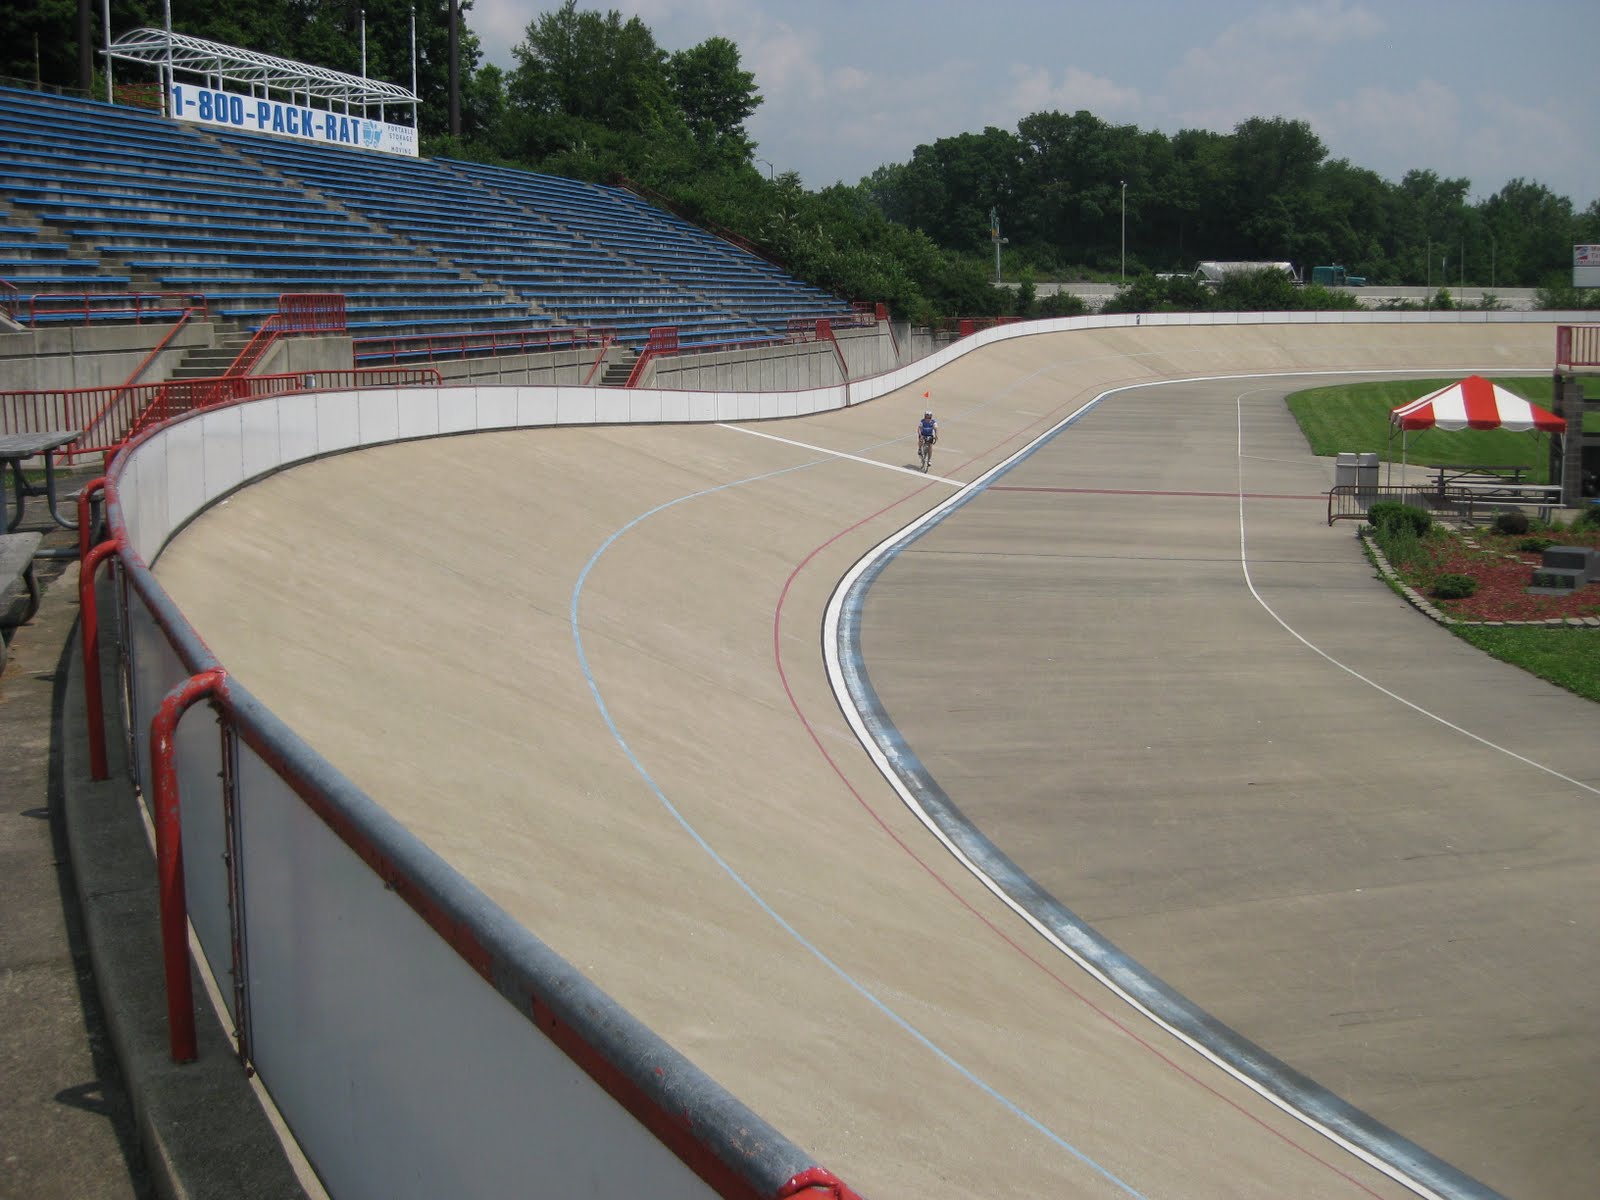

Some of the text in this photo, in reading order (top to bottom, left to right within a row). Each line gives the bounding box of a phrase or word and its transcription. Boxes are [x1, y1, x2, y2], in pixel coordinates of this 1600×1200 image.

[171, 86, 360, 144] 1-800-PACK-RAT
[387, 125, 413, 134] PORTABLE
[389, 133, 412, 142] STORAGE
[391, 146, 411, 155] MOVING
